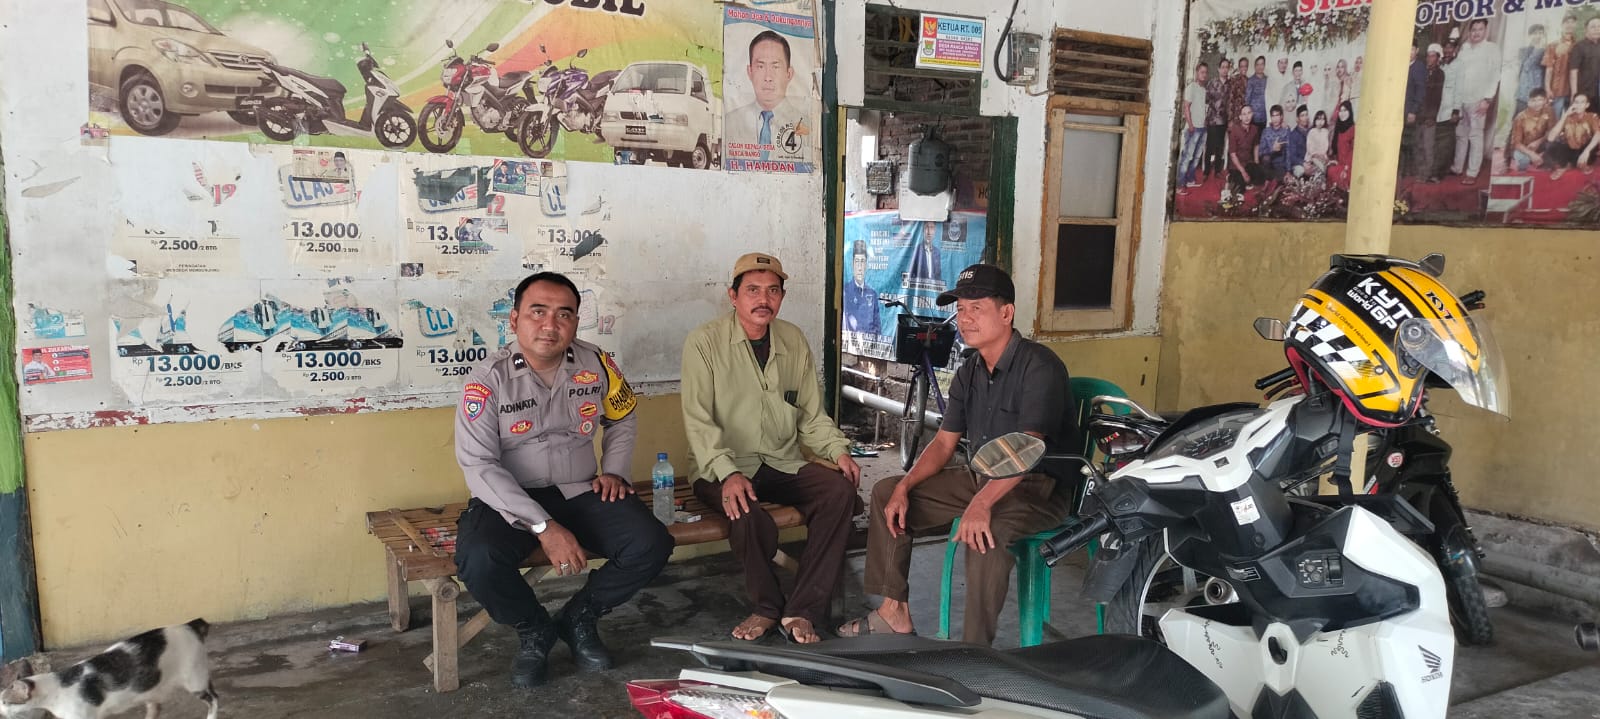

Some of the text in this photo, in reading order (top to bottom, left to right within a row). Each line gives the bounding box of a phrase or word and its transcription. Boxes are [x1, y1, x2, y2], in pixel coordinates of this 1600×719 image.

[1415, 0, 1495, 25] OTOR
[937, 22, 959, 32] KETUA
[960, 24, 970, 33] RT.
[785, 131, 797, 151] 4
[730, 160, 795, 172] H. HAMDAN
[291, 221, 359, 239] 13.000
[415, 225, 425, 233] Rp
[159, 240, 198, 250] 2.500
[306, 242, 342, 252] 2.500
[1356, 276, 1414, 320] KYT
[1369, 305, 1398, 330] GP
[146, 354, 221, 372] 13.000
[294, 351, 362, 368] 13.000
[416, 349, 426, 357] Rp
[428, 347, 487, 364] 13.000
[163, 375, 202, 387] 2.500
[310, 371, 345, 382] 2.500
[568, 385, 601, 398] POLRI
[499, 398, 538, 414] ADINATA
